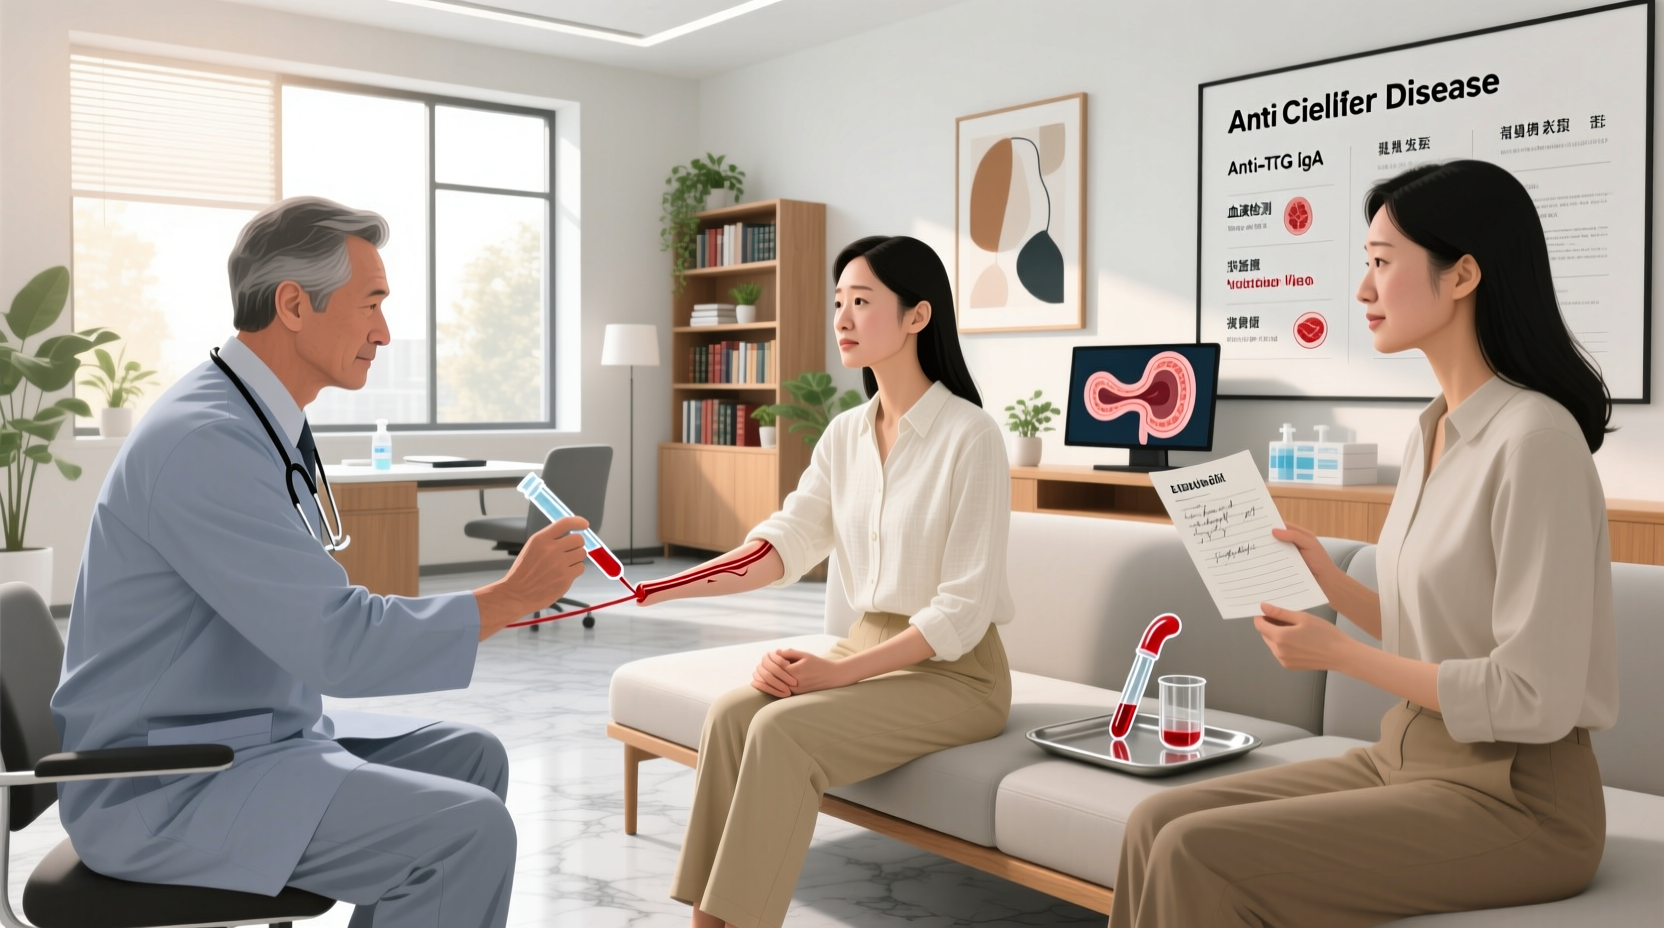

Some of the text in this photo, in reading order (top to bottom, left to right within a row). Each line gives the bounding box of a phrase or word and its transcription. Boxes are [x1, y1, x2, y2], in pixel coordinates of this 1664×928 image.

[1227, 102, 1277, 134] Anti
[1386, 73, 1500, 110] Disease
[1227, 149, 1324, 176] Anti-TTG IgA
